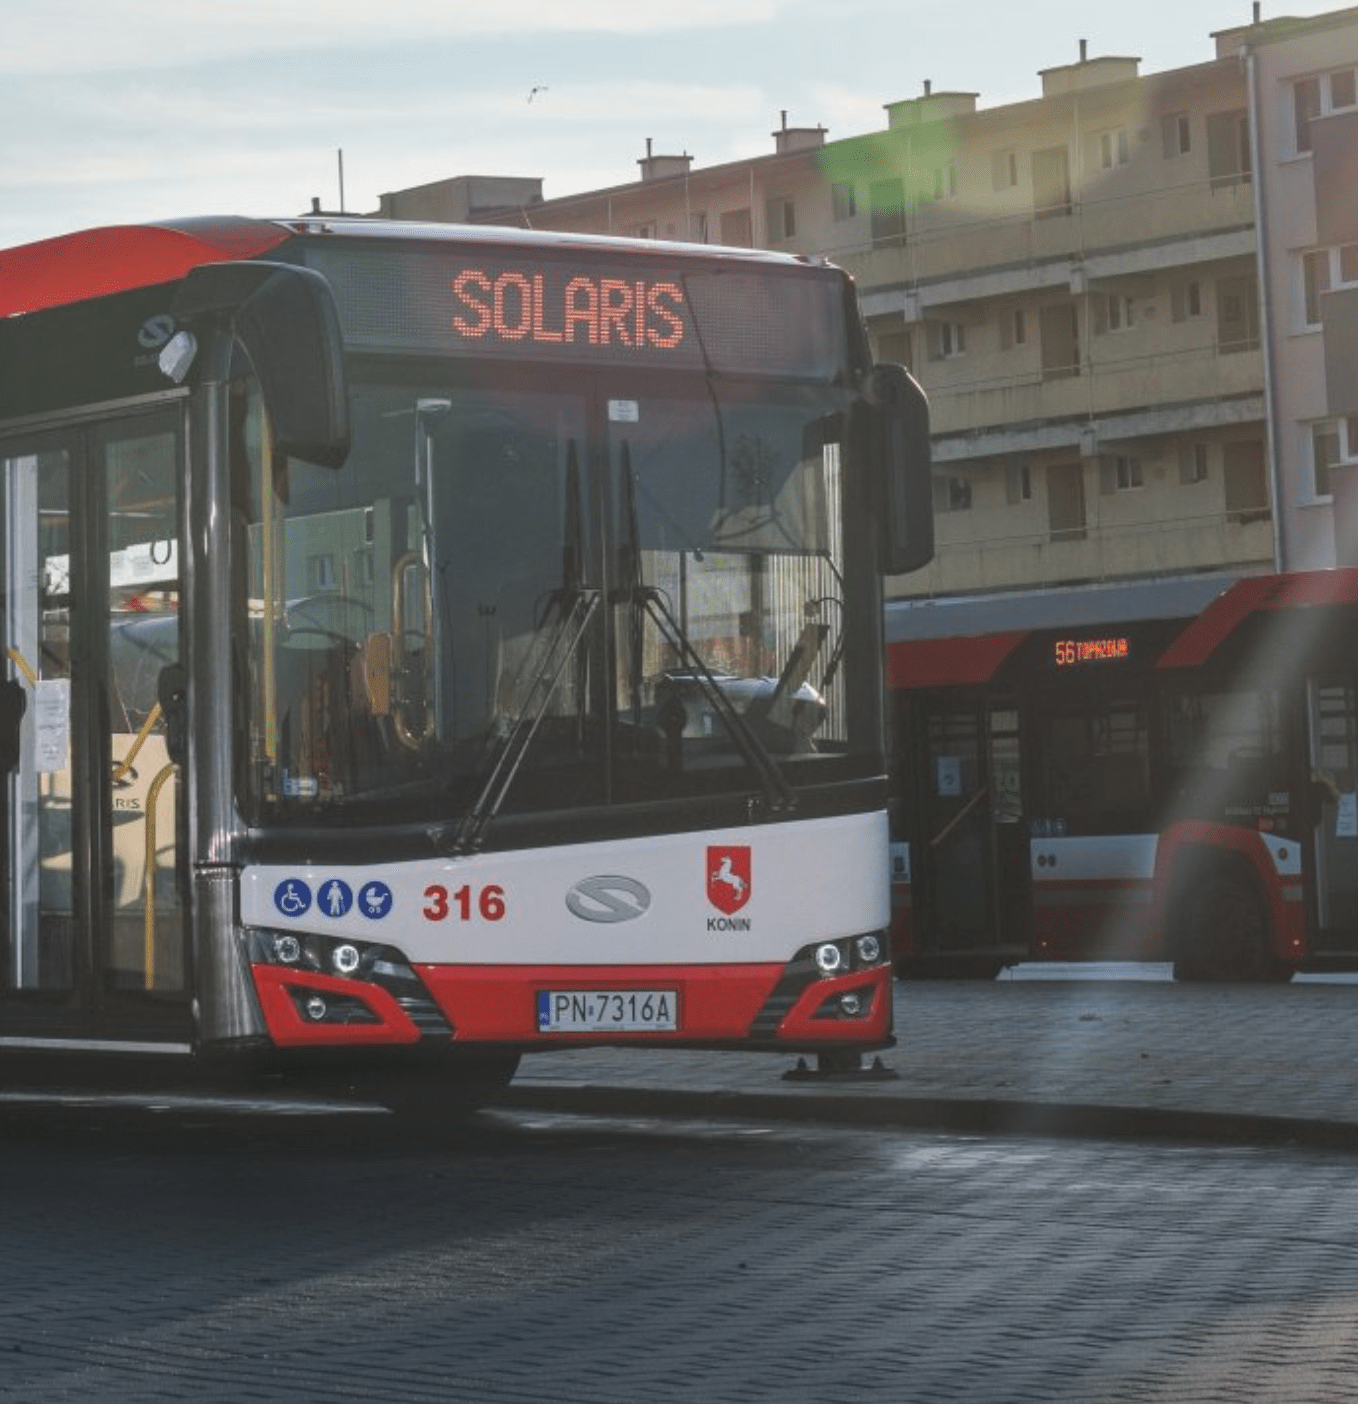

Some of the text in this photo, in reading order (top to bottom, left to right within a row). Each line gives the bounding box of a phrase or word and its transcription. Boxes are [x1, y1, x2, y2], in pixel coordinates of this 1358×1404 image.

[453, 269, 684, 349] SOLARIS
[1055, 640, 1075, 665] 56
[423, 885, 505, 921] 316
[707, 918, 751, 931] KONIN
